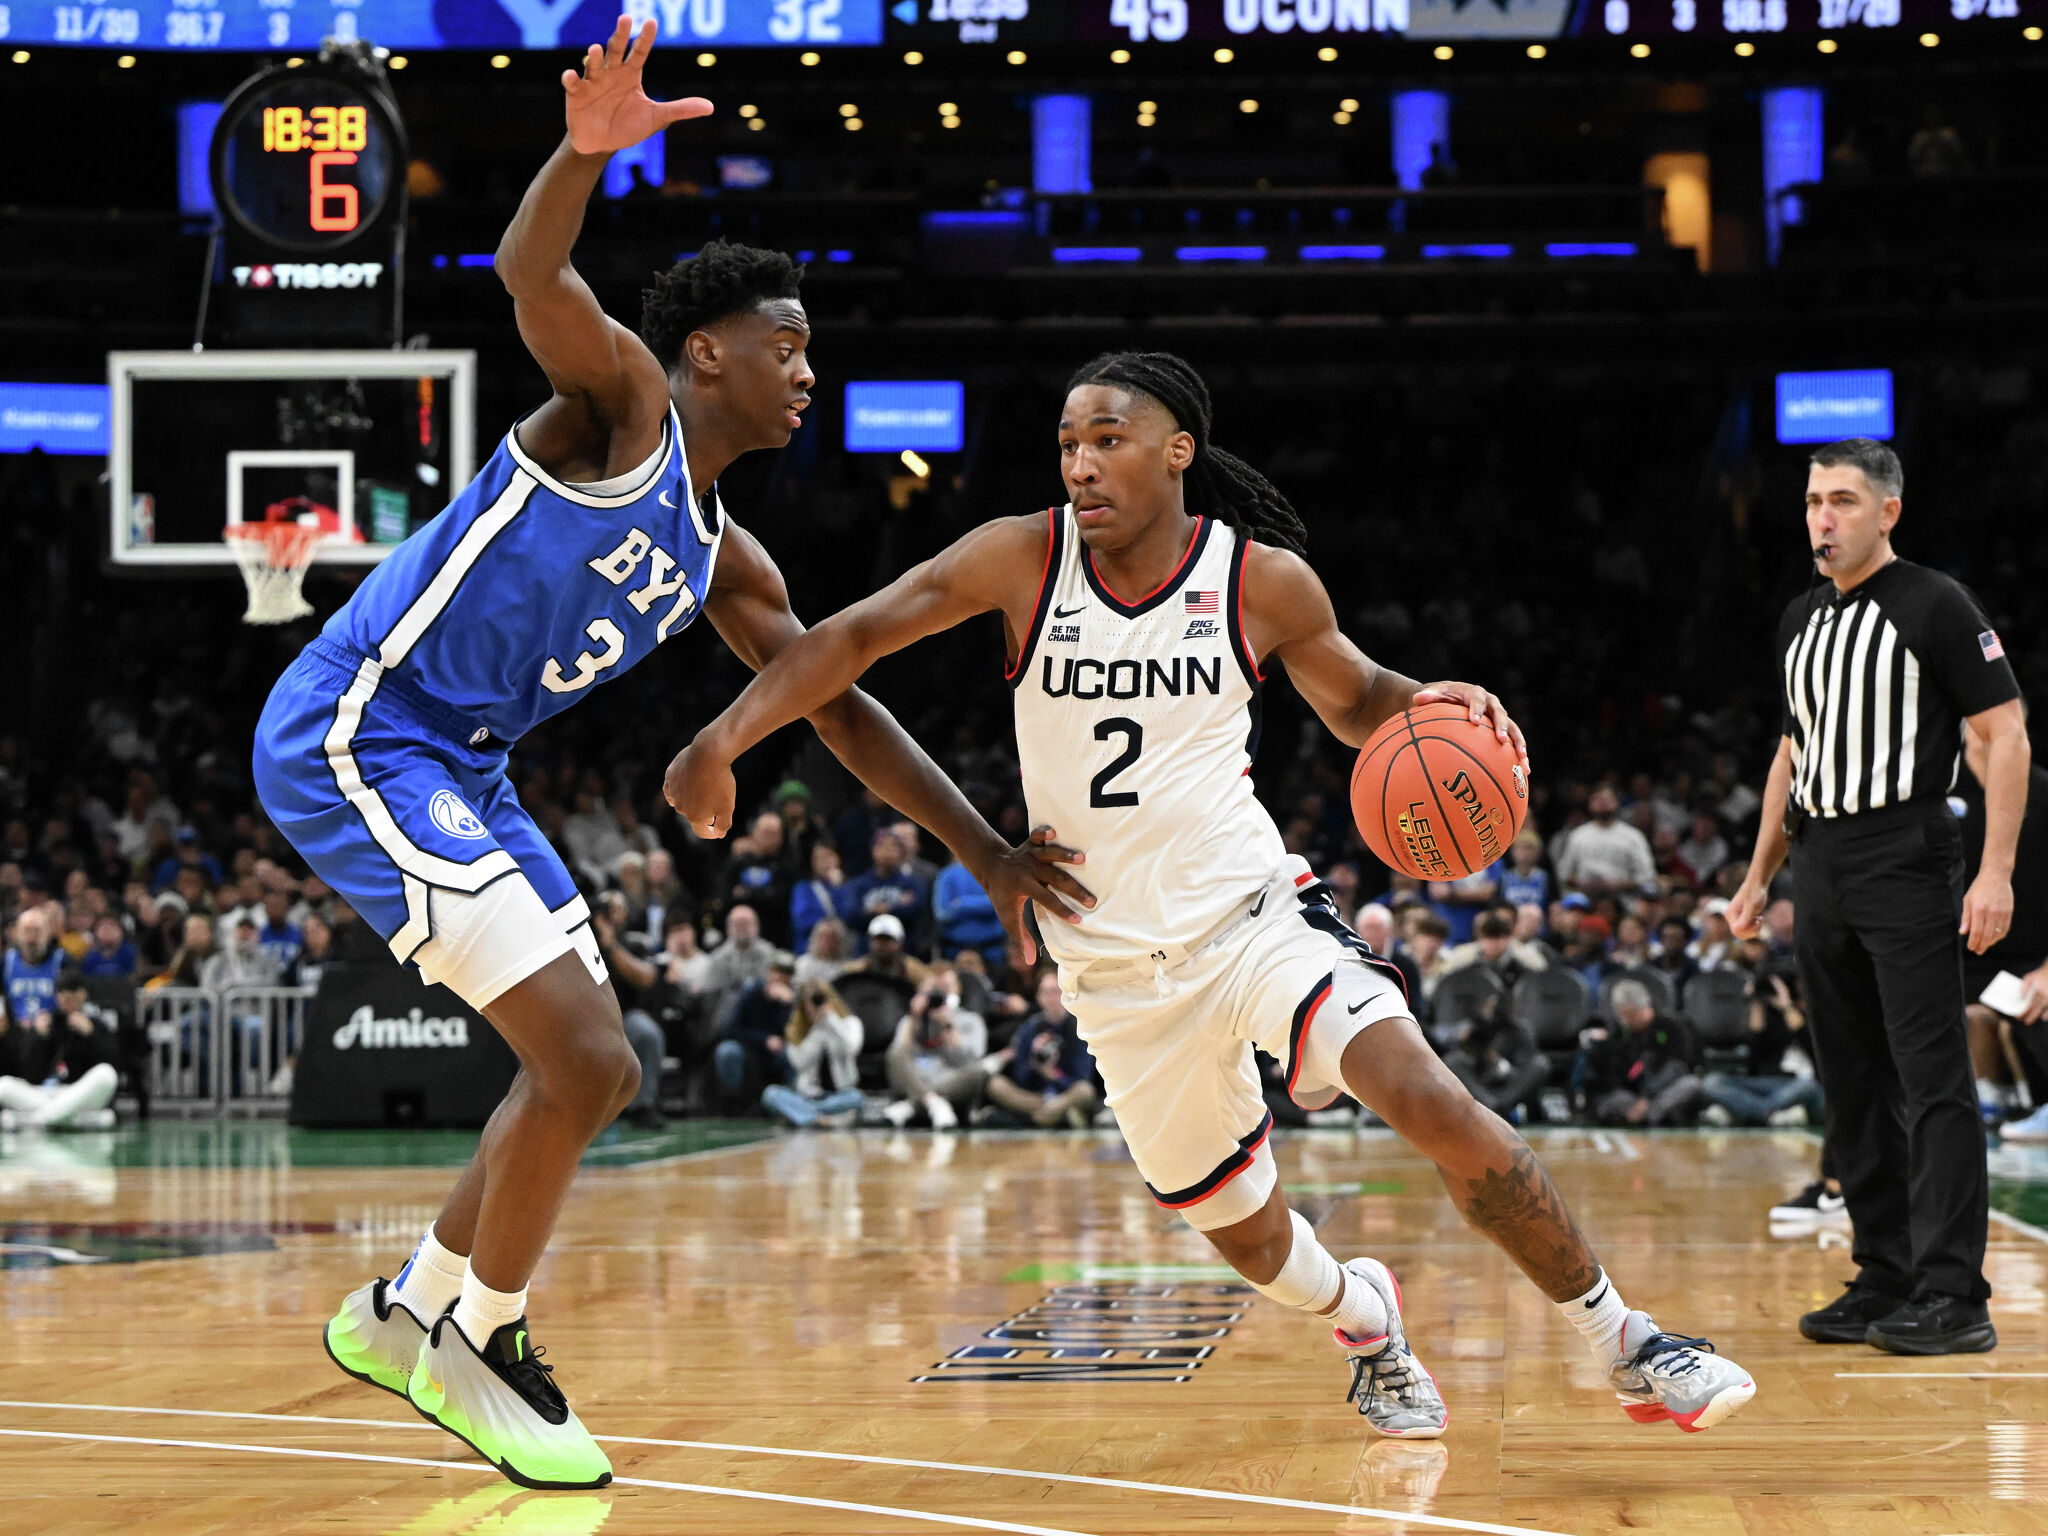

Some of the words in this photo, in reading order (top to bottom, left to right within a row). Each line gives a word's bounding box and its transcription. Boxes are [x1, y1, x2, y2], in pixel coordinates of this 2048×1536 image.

[768, 0, 842, 42] 32
[1110, 0, 1188, 42] 45
[263, 106, 367, 152] 18:38
[310, 151, 359, 232] 6
[1051, 625, 1063, 634] BE
[1065, 625, 1081, 634] THE
[1185, 627, 1221, 636] EAST
[1189, 619, 1215, 628] BIG
[540, 617, 626, 693] 3
[1042, 655, 1222, 700] UCONN
[1090, 717, 1143, 809] 2
[332, 1004, 469, 1050] Amica
